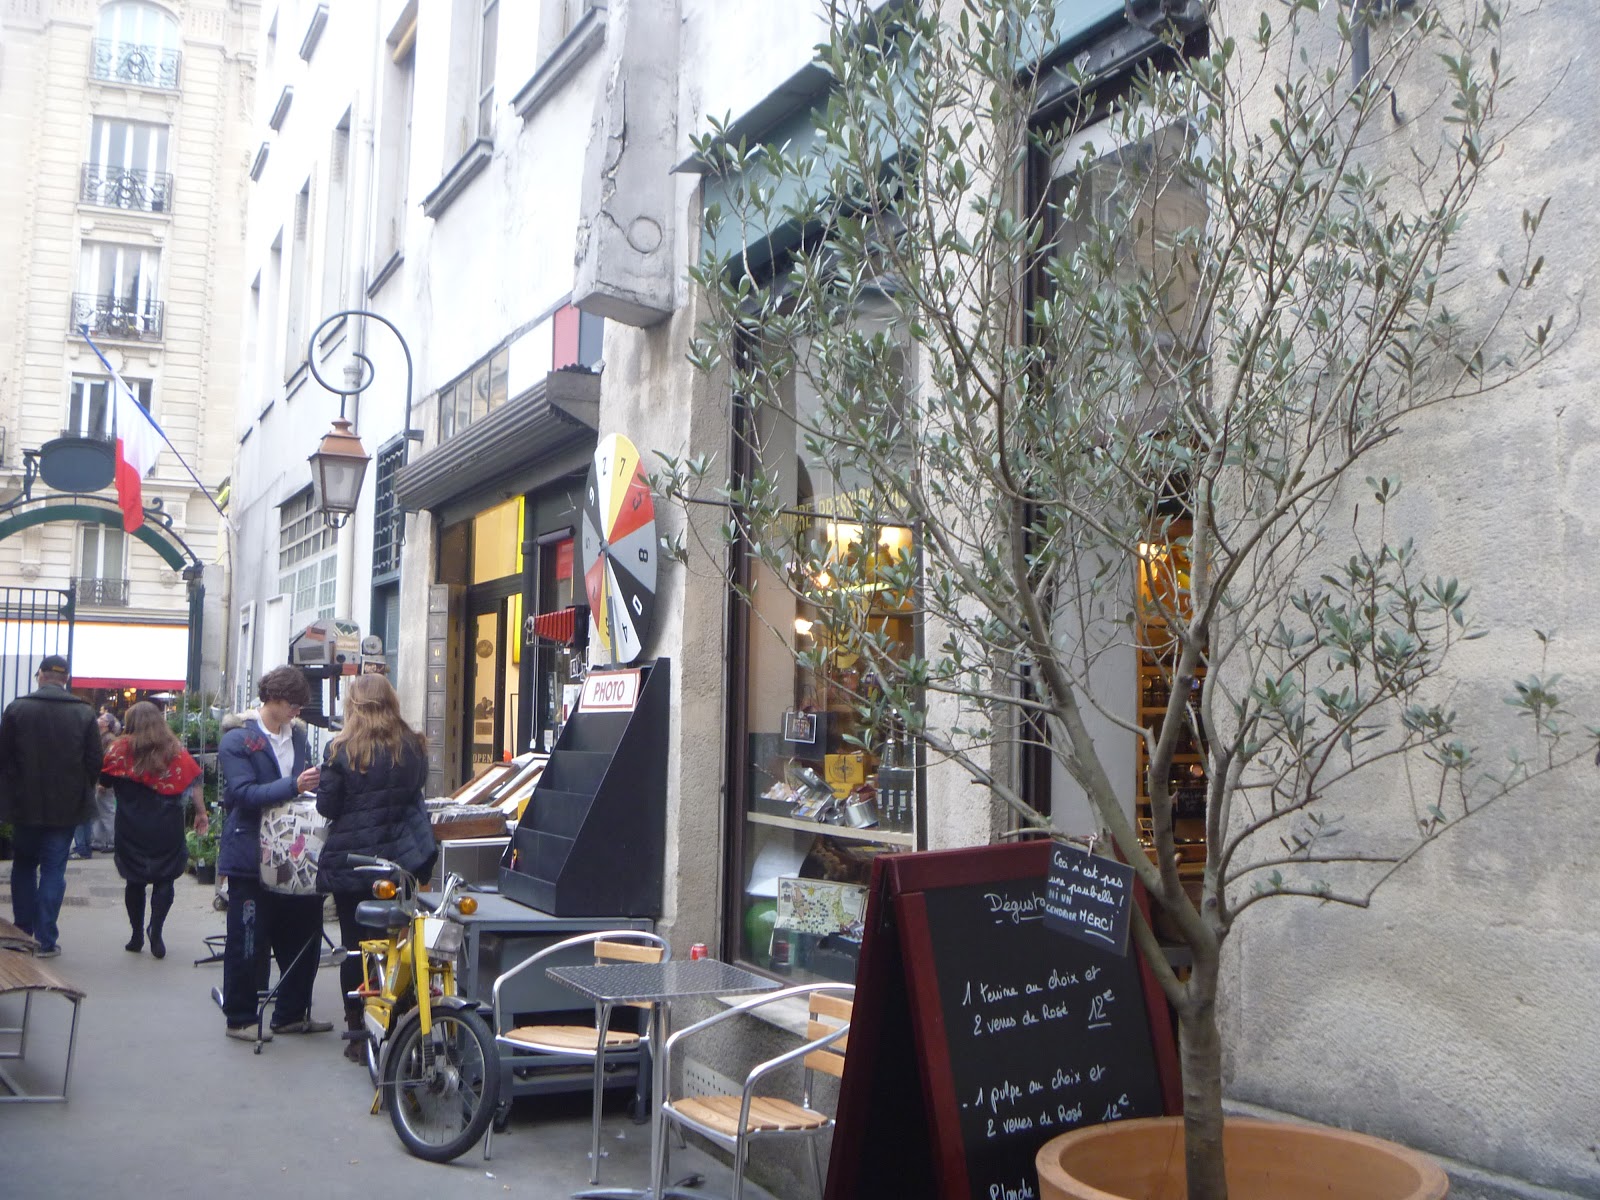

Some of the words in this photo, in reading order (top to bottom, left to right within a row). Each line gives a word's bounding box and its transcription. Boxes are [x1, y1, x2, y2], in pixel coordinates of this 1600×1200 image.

[620, 457, 626, 477] 7
[638, 547, 648, 563] 8
[593, 680, 625, 702] PHOTO
[472, 753, 493, 764] OPEN
[1054, 851, 1068, 869] Ceci
[1072, 860, 1098, 879] n'est
[1100, 874, 1123, 888] pas
[1048, 876, 1065, 886] une
[1068, 884, 1114, 905] poubelle
[1061, 894, 1072, 905] UN
[1046, 904, 1077, 922] CENDRIER
[962, 980, 972, 1006] 1
[980, 983, 1018, 1003] terrine
[1026, 983, 1043, 994] au
[1048, 969, 1079, 989] choix
[1085, 965, 1101, 981] et
[973, 1014, 982, 1036] 2
[986, 1016, 1016, 1034] verres
[1022, 1010, 1040, 1025] de
[1042, 1001, 1068, 1021] Rosé
[975, 1087, 984, 1106] 1
[990, 1080, 1023, 1114] pulpe
[1029, 1080, 1043, 1094] au
[1052, 1068, 1081, 1089] choix
[1089, 1064, 1106, 1081] et
[987, 1118, 997, 1137] 2
[1003, 1115, 1033, 1133] verres
[1040, 1111, 1053, 1124] de
[1058, 1102, 1083, 1123] Rosé
[989, 1178, 1035, 1200] Planche
